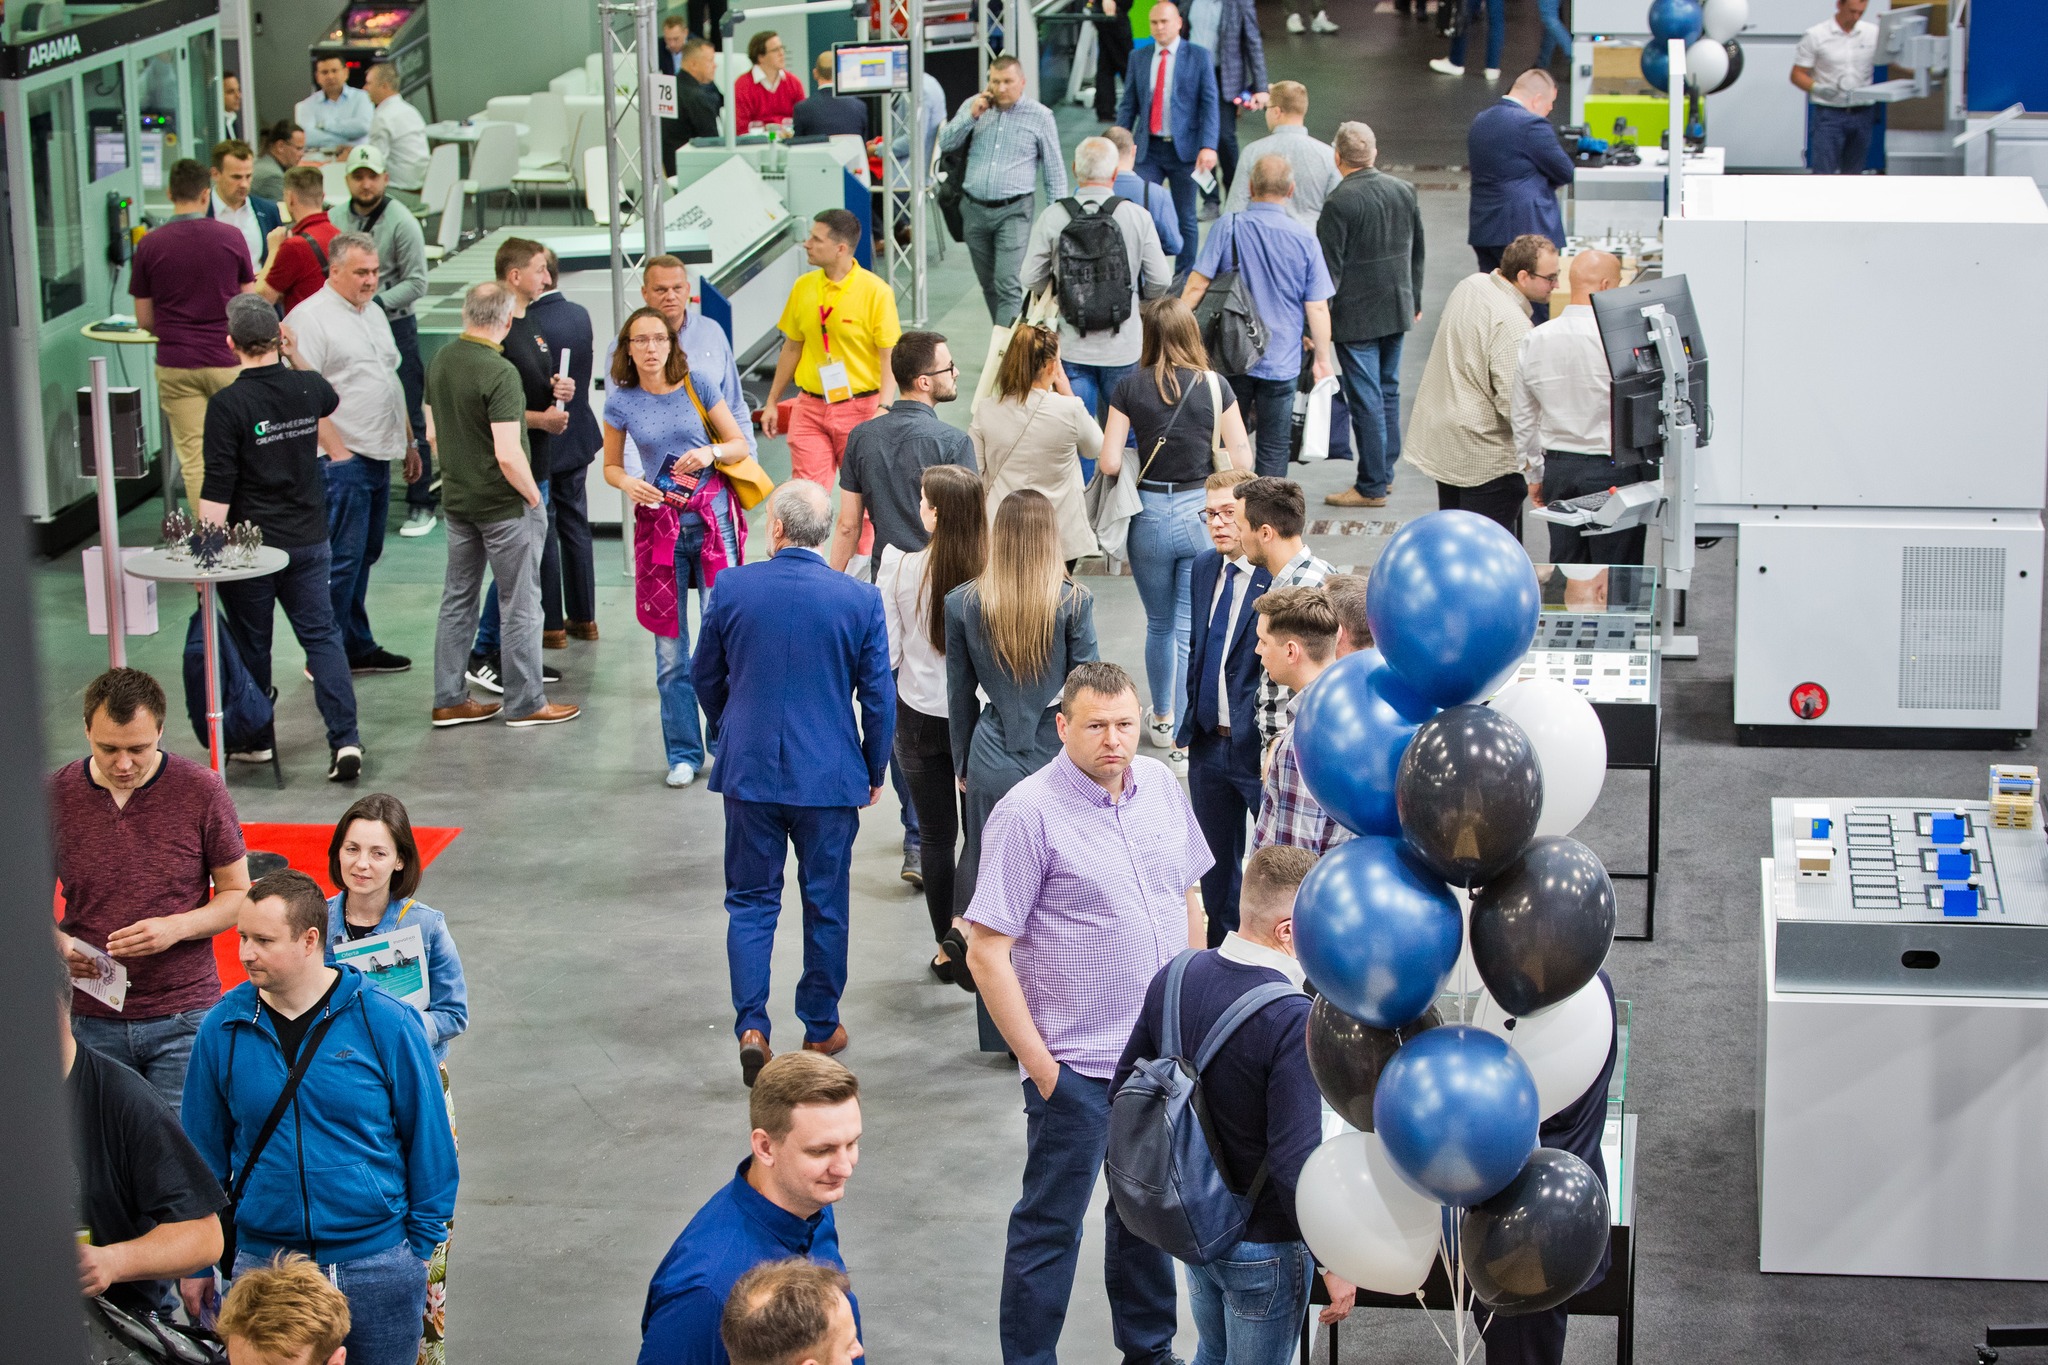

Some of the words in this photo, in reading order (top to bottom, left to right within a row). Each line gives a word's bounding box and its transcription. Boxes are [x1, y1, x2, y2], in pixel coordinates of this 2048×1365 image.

[28, 33, 82, 69] ARAMA
[658, 84, 673, 101] 78
[340, 949, 360, 959] Oferta
